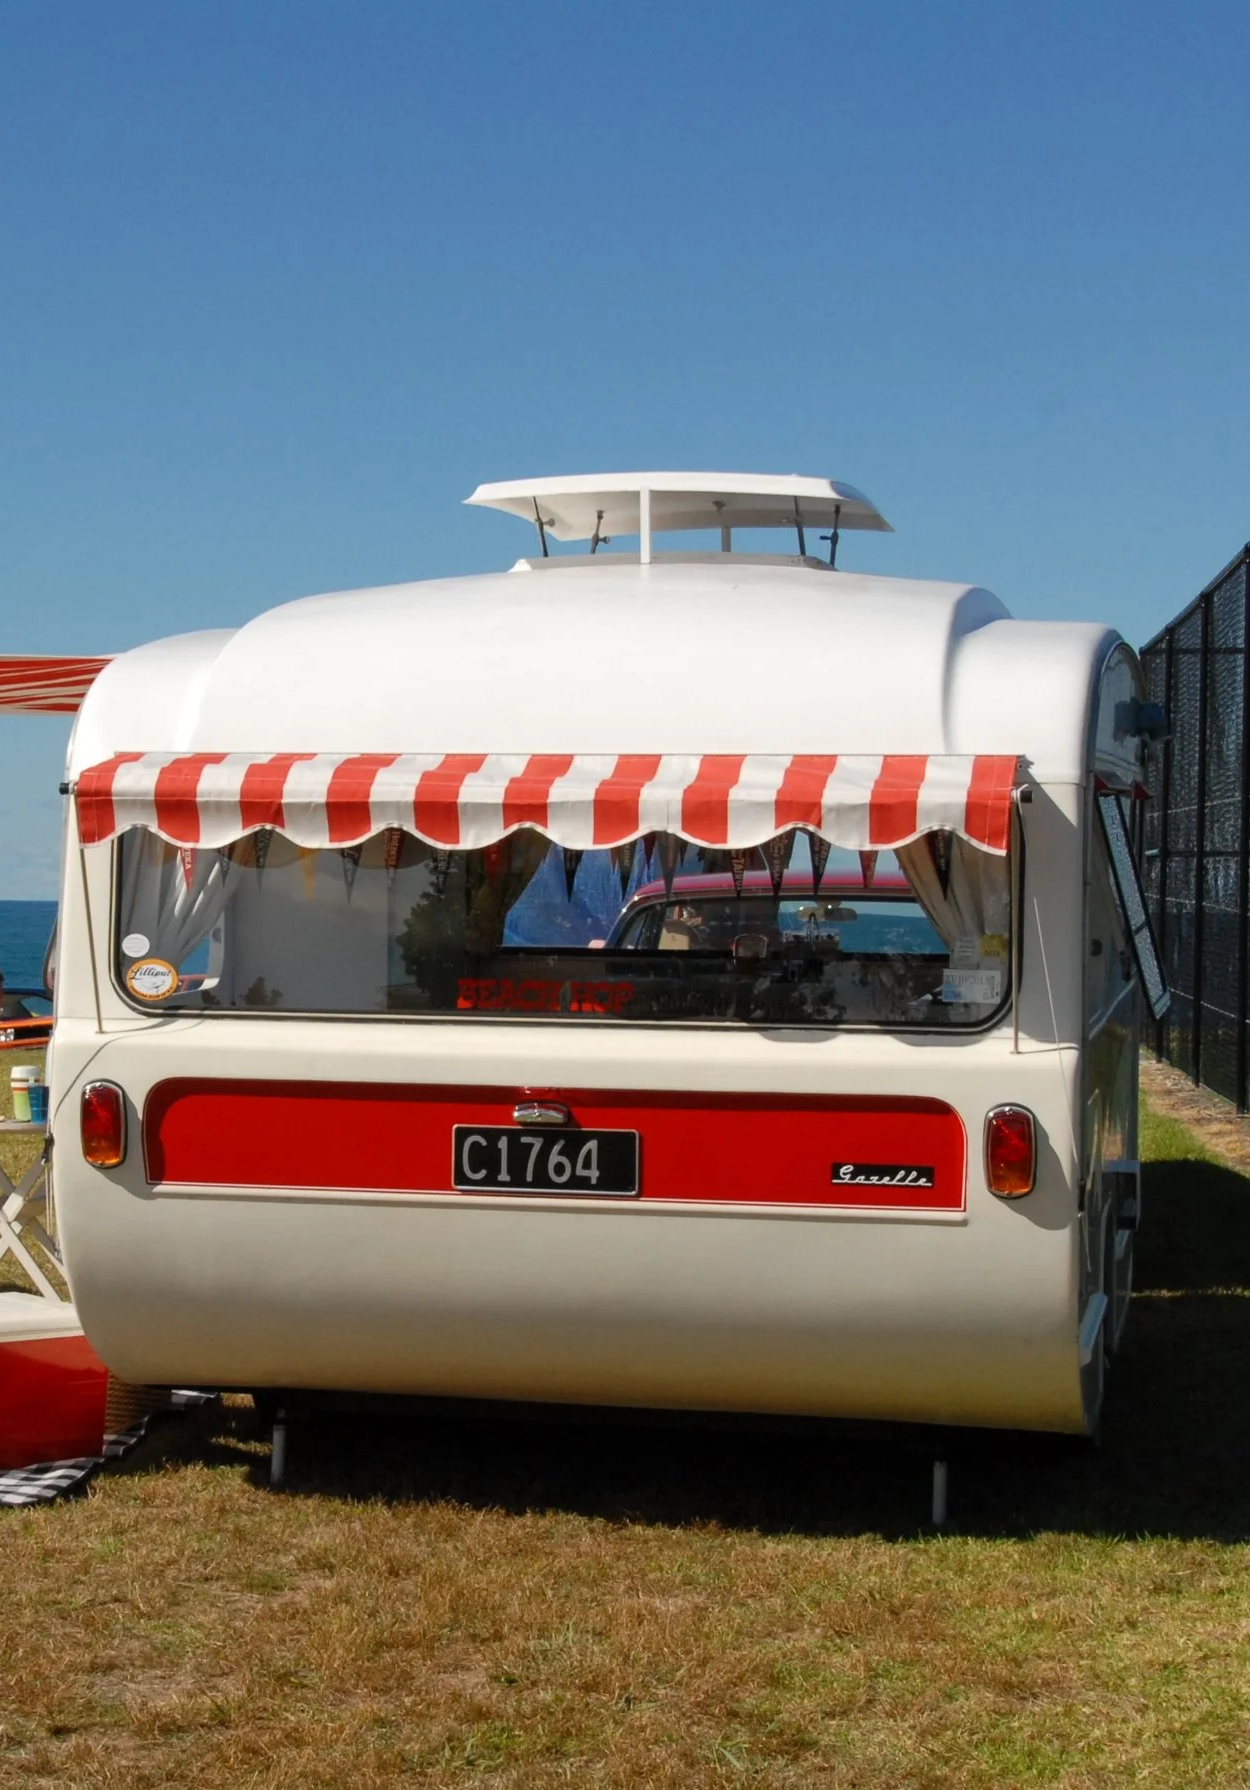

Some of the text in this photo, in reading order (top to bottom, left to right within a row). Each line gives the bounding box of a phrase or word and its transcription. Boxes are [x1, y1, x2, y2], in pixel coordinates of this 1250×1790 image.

[457, 978, 635, 1013] BEACH HOP
[462, 1135, 599, 1185] C1764
[832, 1164, 932, 1186] Gazelle
